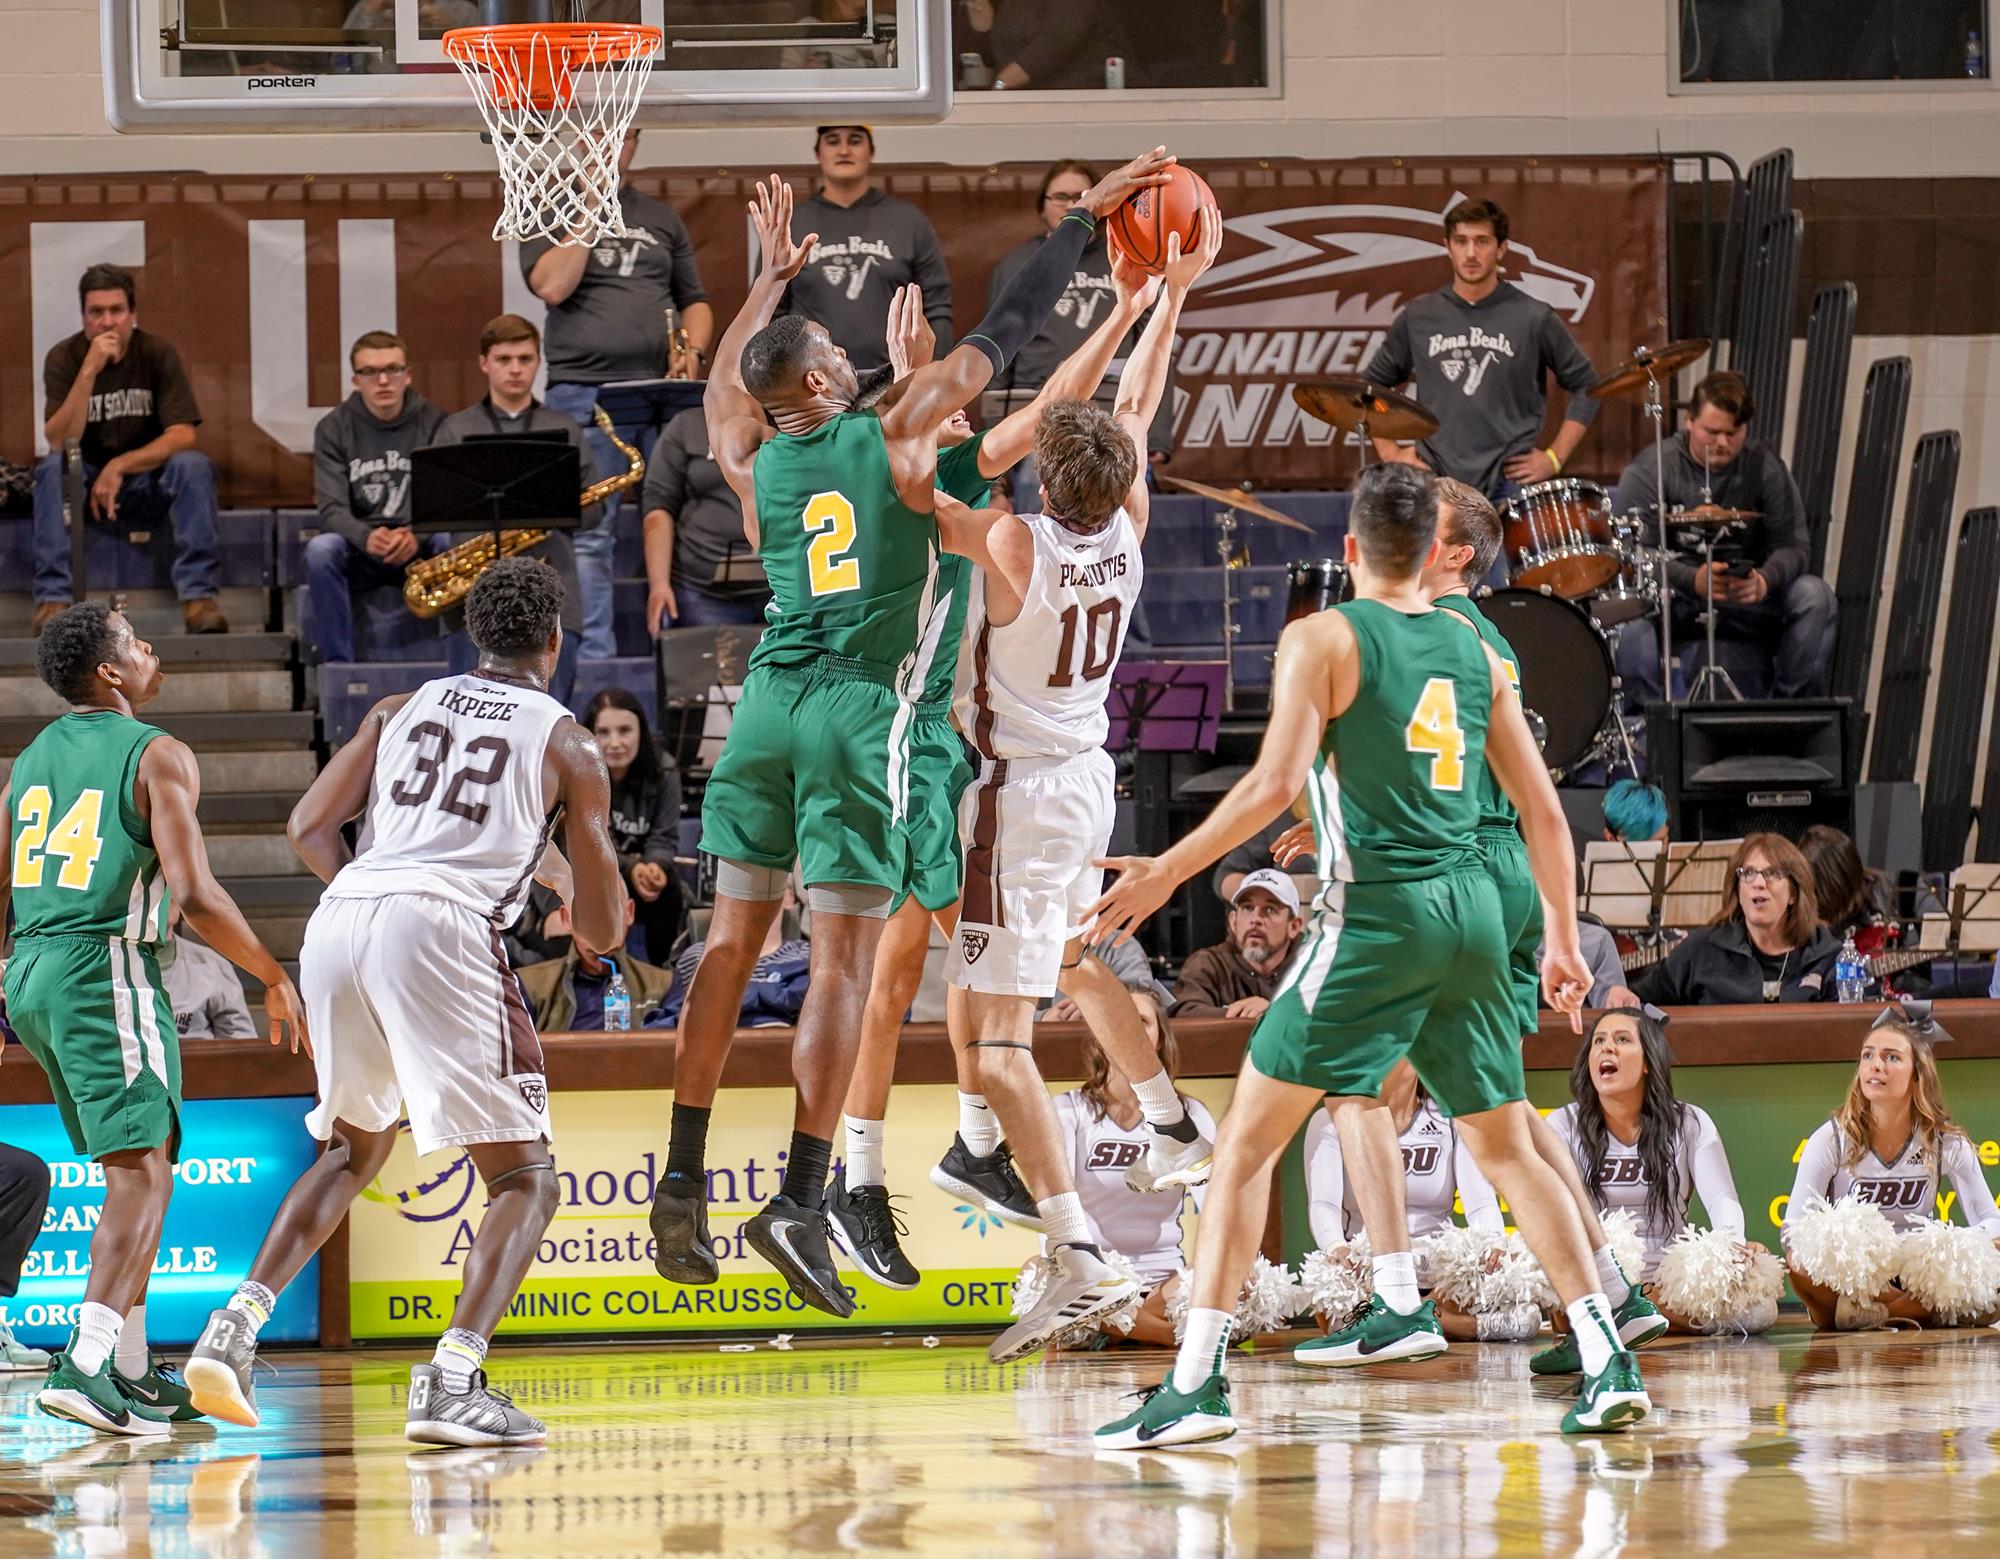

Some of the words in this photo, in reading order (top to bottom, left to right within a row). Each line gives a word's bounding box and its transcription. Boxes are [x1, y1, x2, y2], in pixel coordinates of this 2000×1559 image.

[802, 490, 860, 597] 2
[1047, 597, 1122, 687] 10
[438, 689, 519, 721] IKPEZE
[1405, 677, 1465, 791] 4
[391, 720, 511, 825] 32
[12, 785, 104, 891] 24
[1086, 1139, 1150, 1171] SB
[1400, 1144, 1441, 1176] BU
[1851, 1176, 1931, 1210] SBU
[709, 1222, 749, 1260] of
[388, 1296, 442, 1321] DR.
[604, 1287, 807, 1315] COLARUSSO
[202, 1318, 236, 1352] 13
